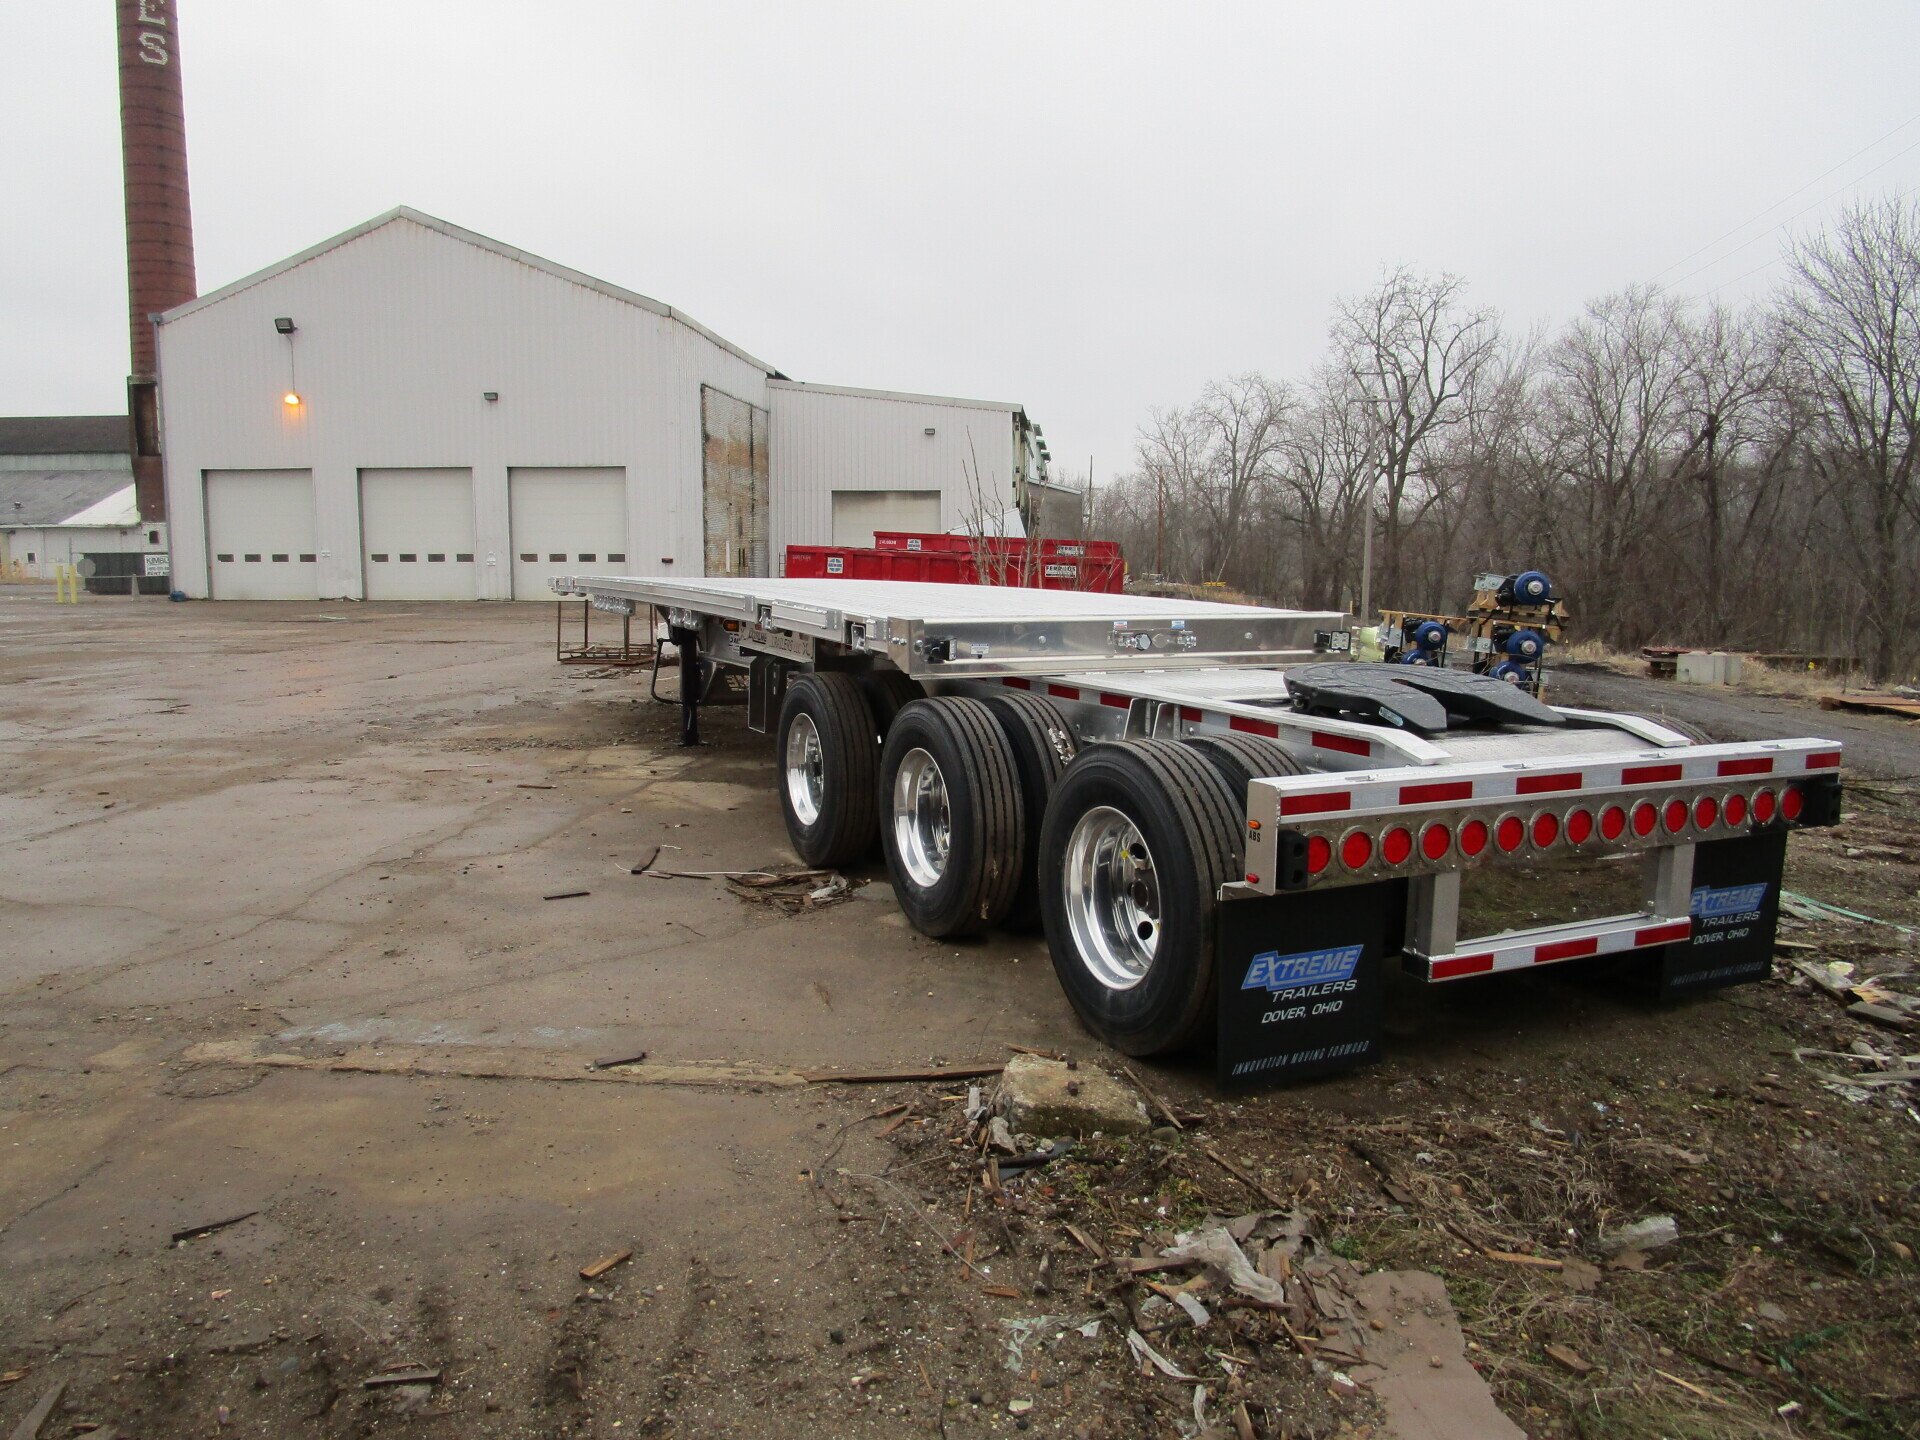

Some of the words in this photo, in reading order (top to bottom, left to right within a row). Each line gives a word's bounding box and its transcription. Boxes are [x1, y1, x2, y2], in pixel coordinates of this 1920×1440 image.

[1248, 830, 1261, 842] ABS
[1702, 911, 1760, 928] TRAILERS
[1727, 928, 1750, 939] OHIO
[1249, 950, 1358, 987] EXTREME
[1272, 979, 1358, 1003] TRAILERS
[1261, 1006, 1307, 1024] DOVER,
[1311, 1000, 1343, 1015] OHIO
[1231, 1054, 1288, 1075] INNOVATION
